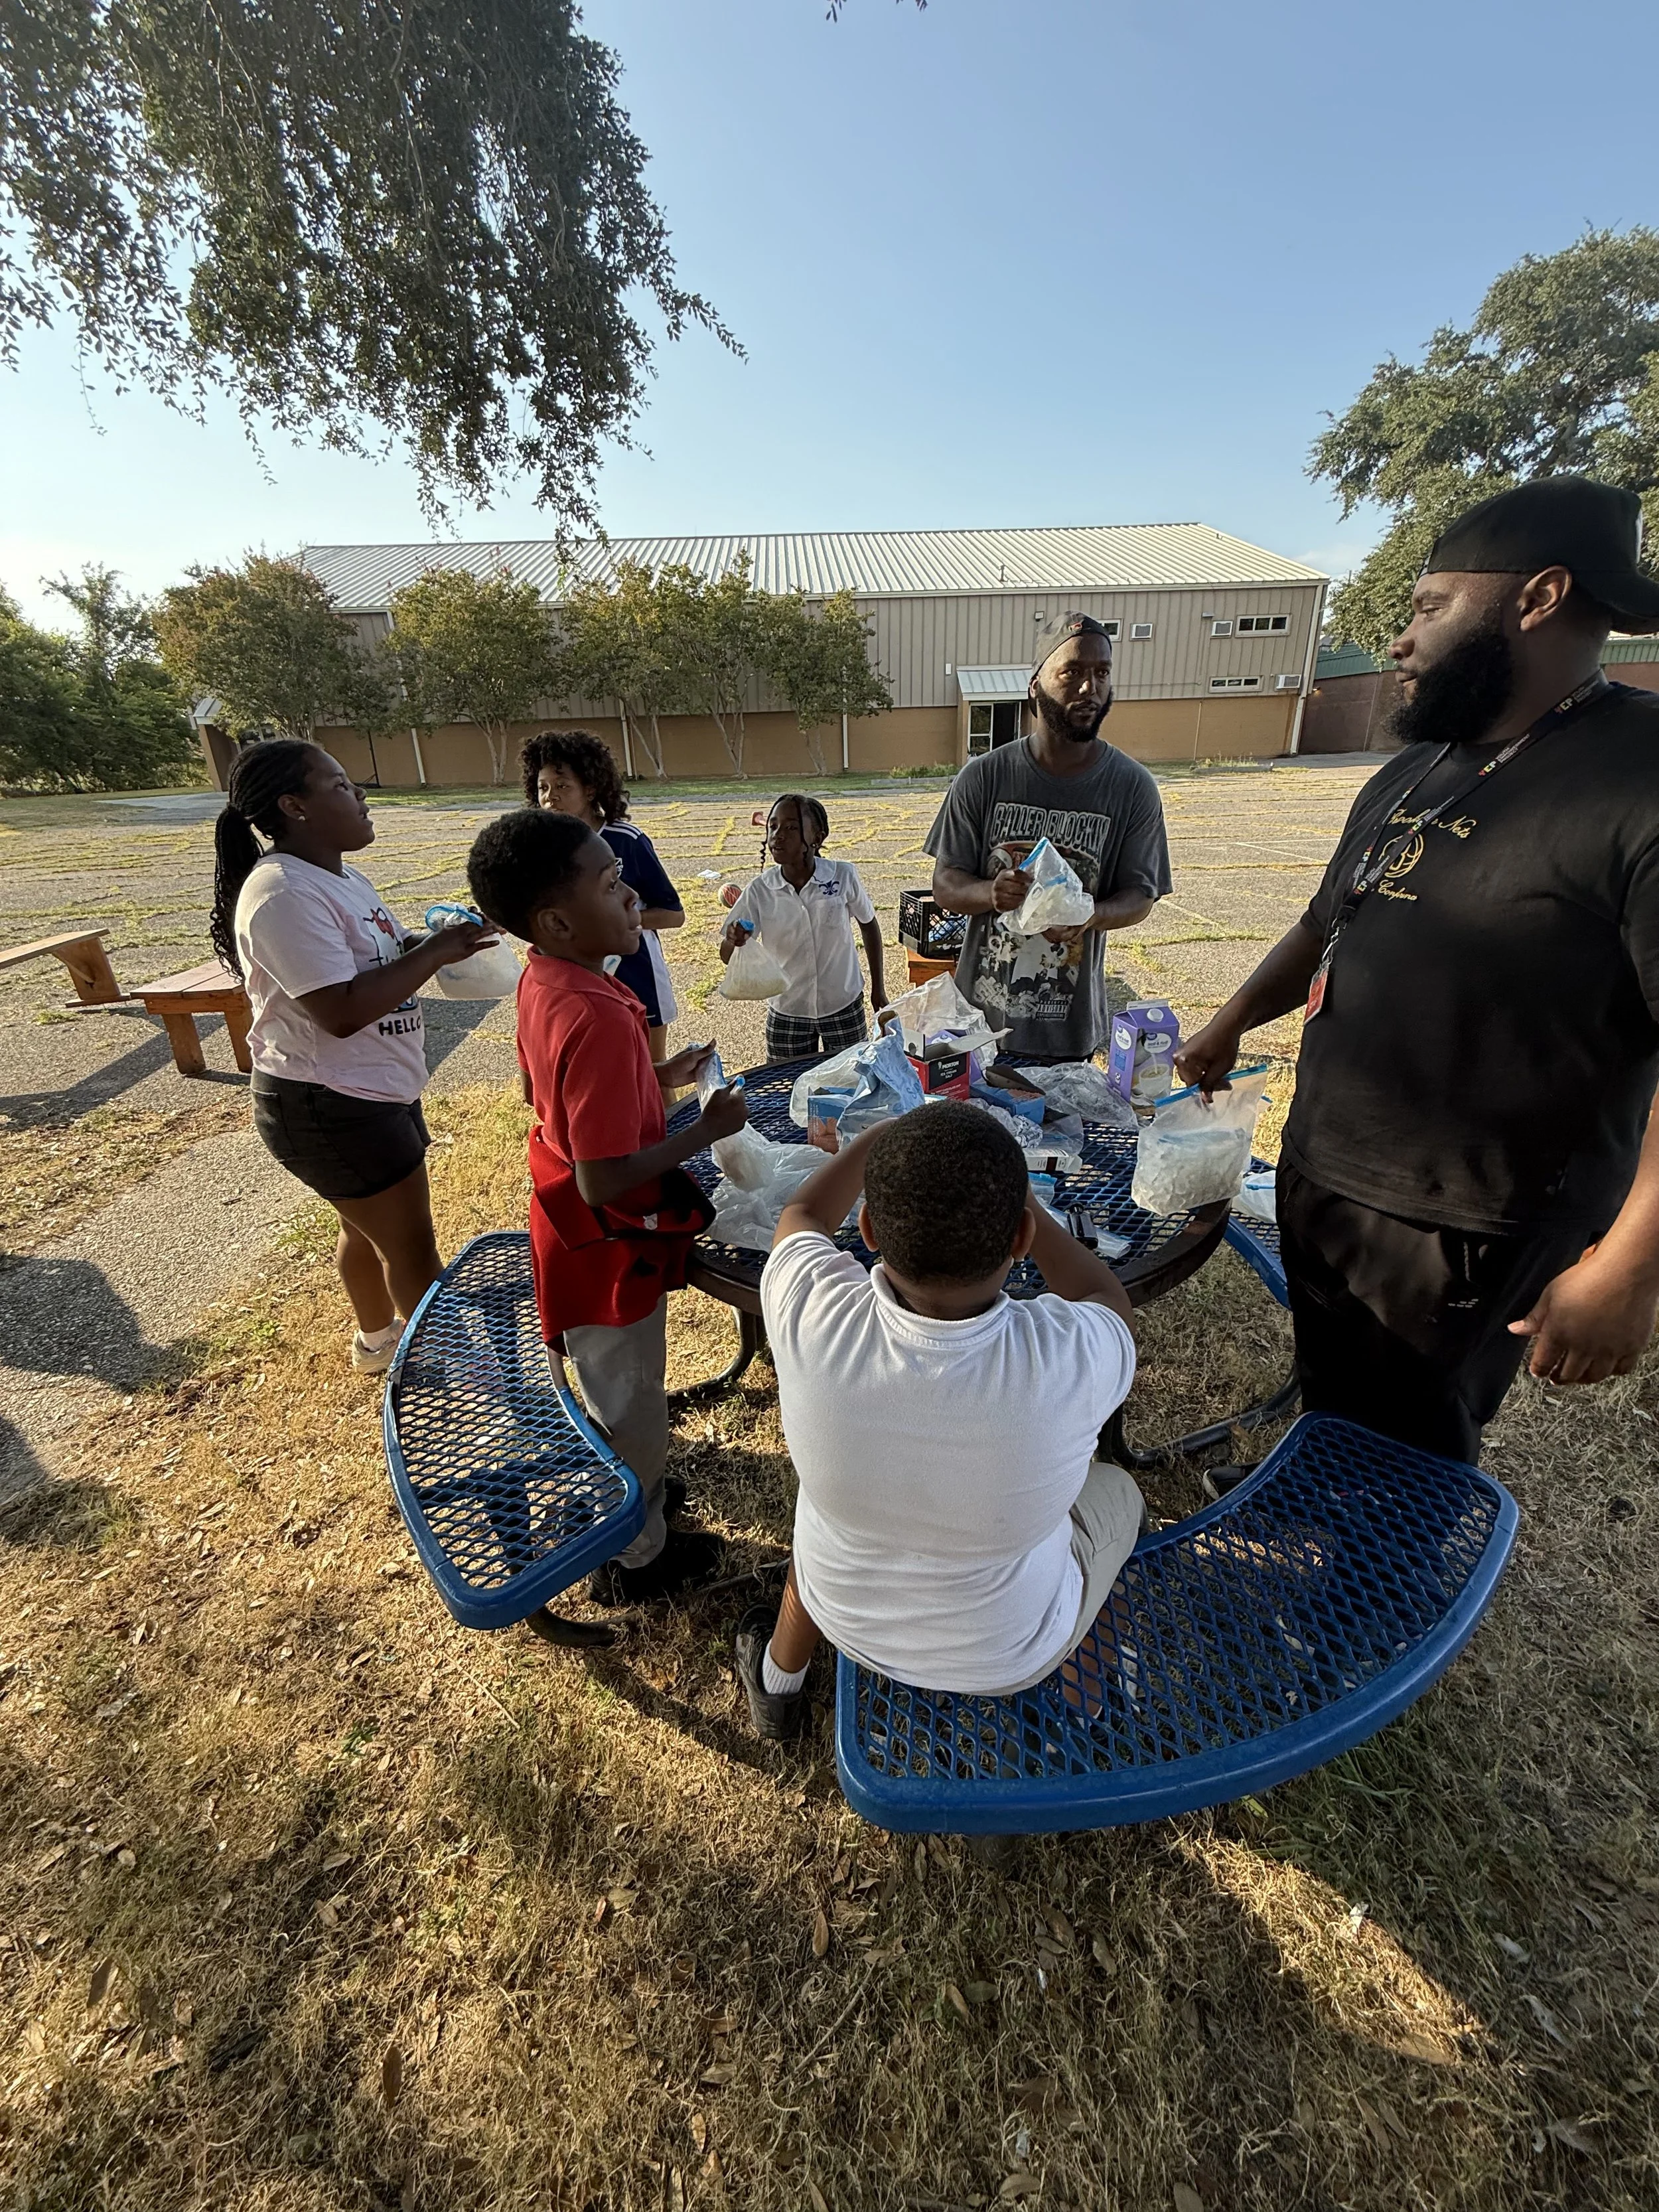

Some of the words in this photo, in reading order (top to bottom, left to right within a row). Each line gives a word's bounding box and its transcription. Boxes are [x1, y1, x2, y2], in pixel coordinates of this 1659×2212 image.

[1478, 761, 1496, 776] YEP
[991, 803, 1046, 844] BALLER
[1439, 815, 1477, 839] Nets
[1353, 880, 1368, 895] YEP
[942, 1061, 960, 1069] MORTON
